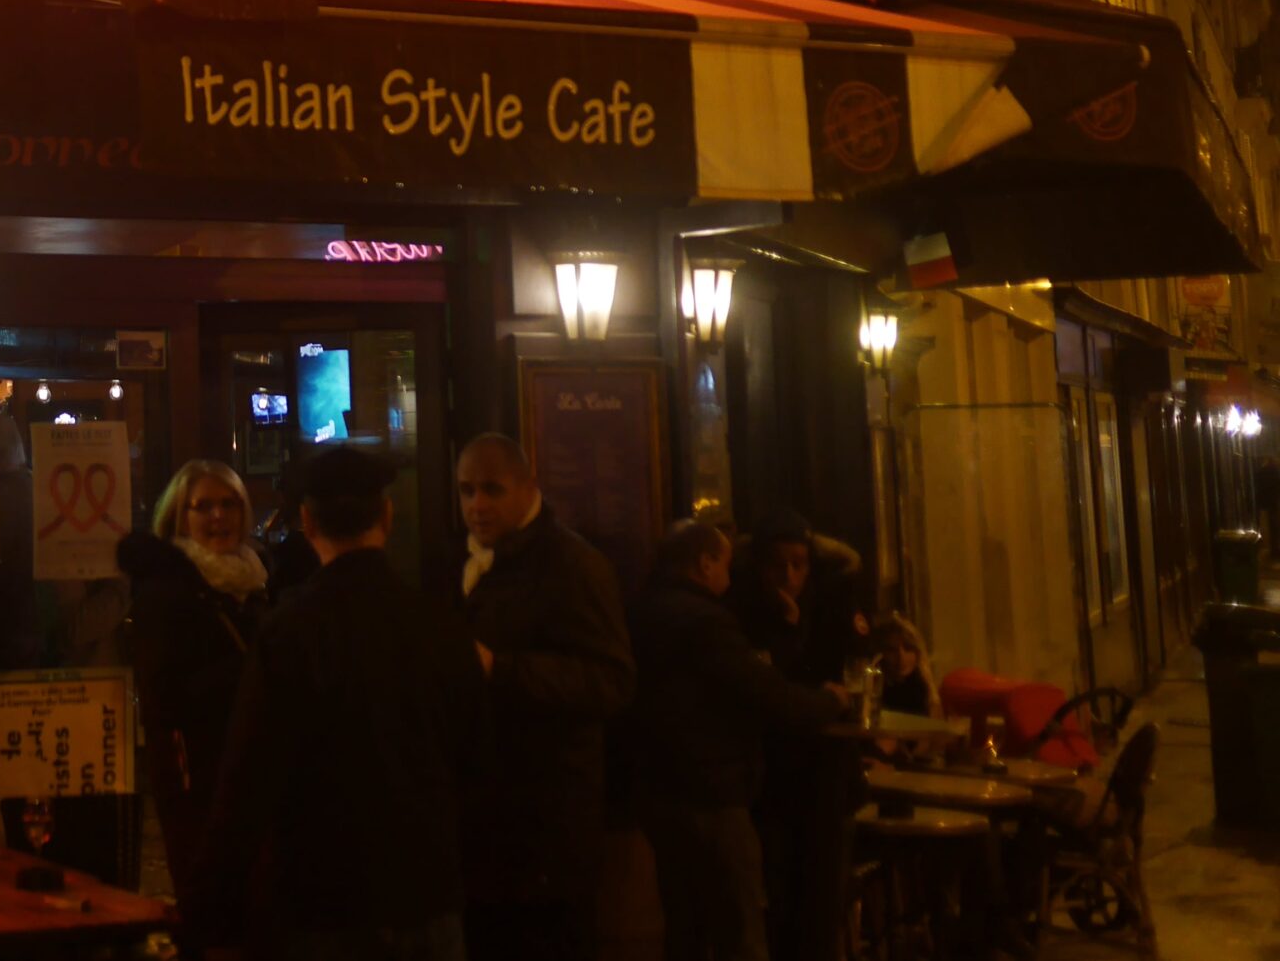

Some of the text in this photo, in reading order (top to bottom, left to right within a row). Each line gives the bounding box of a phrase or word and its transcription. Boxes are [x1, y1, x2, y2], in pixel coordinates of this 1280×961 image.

[180, 54, 657, 157] Italian Style Cafe
